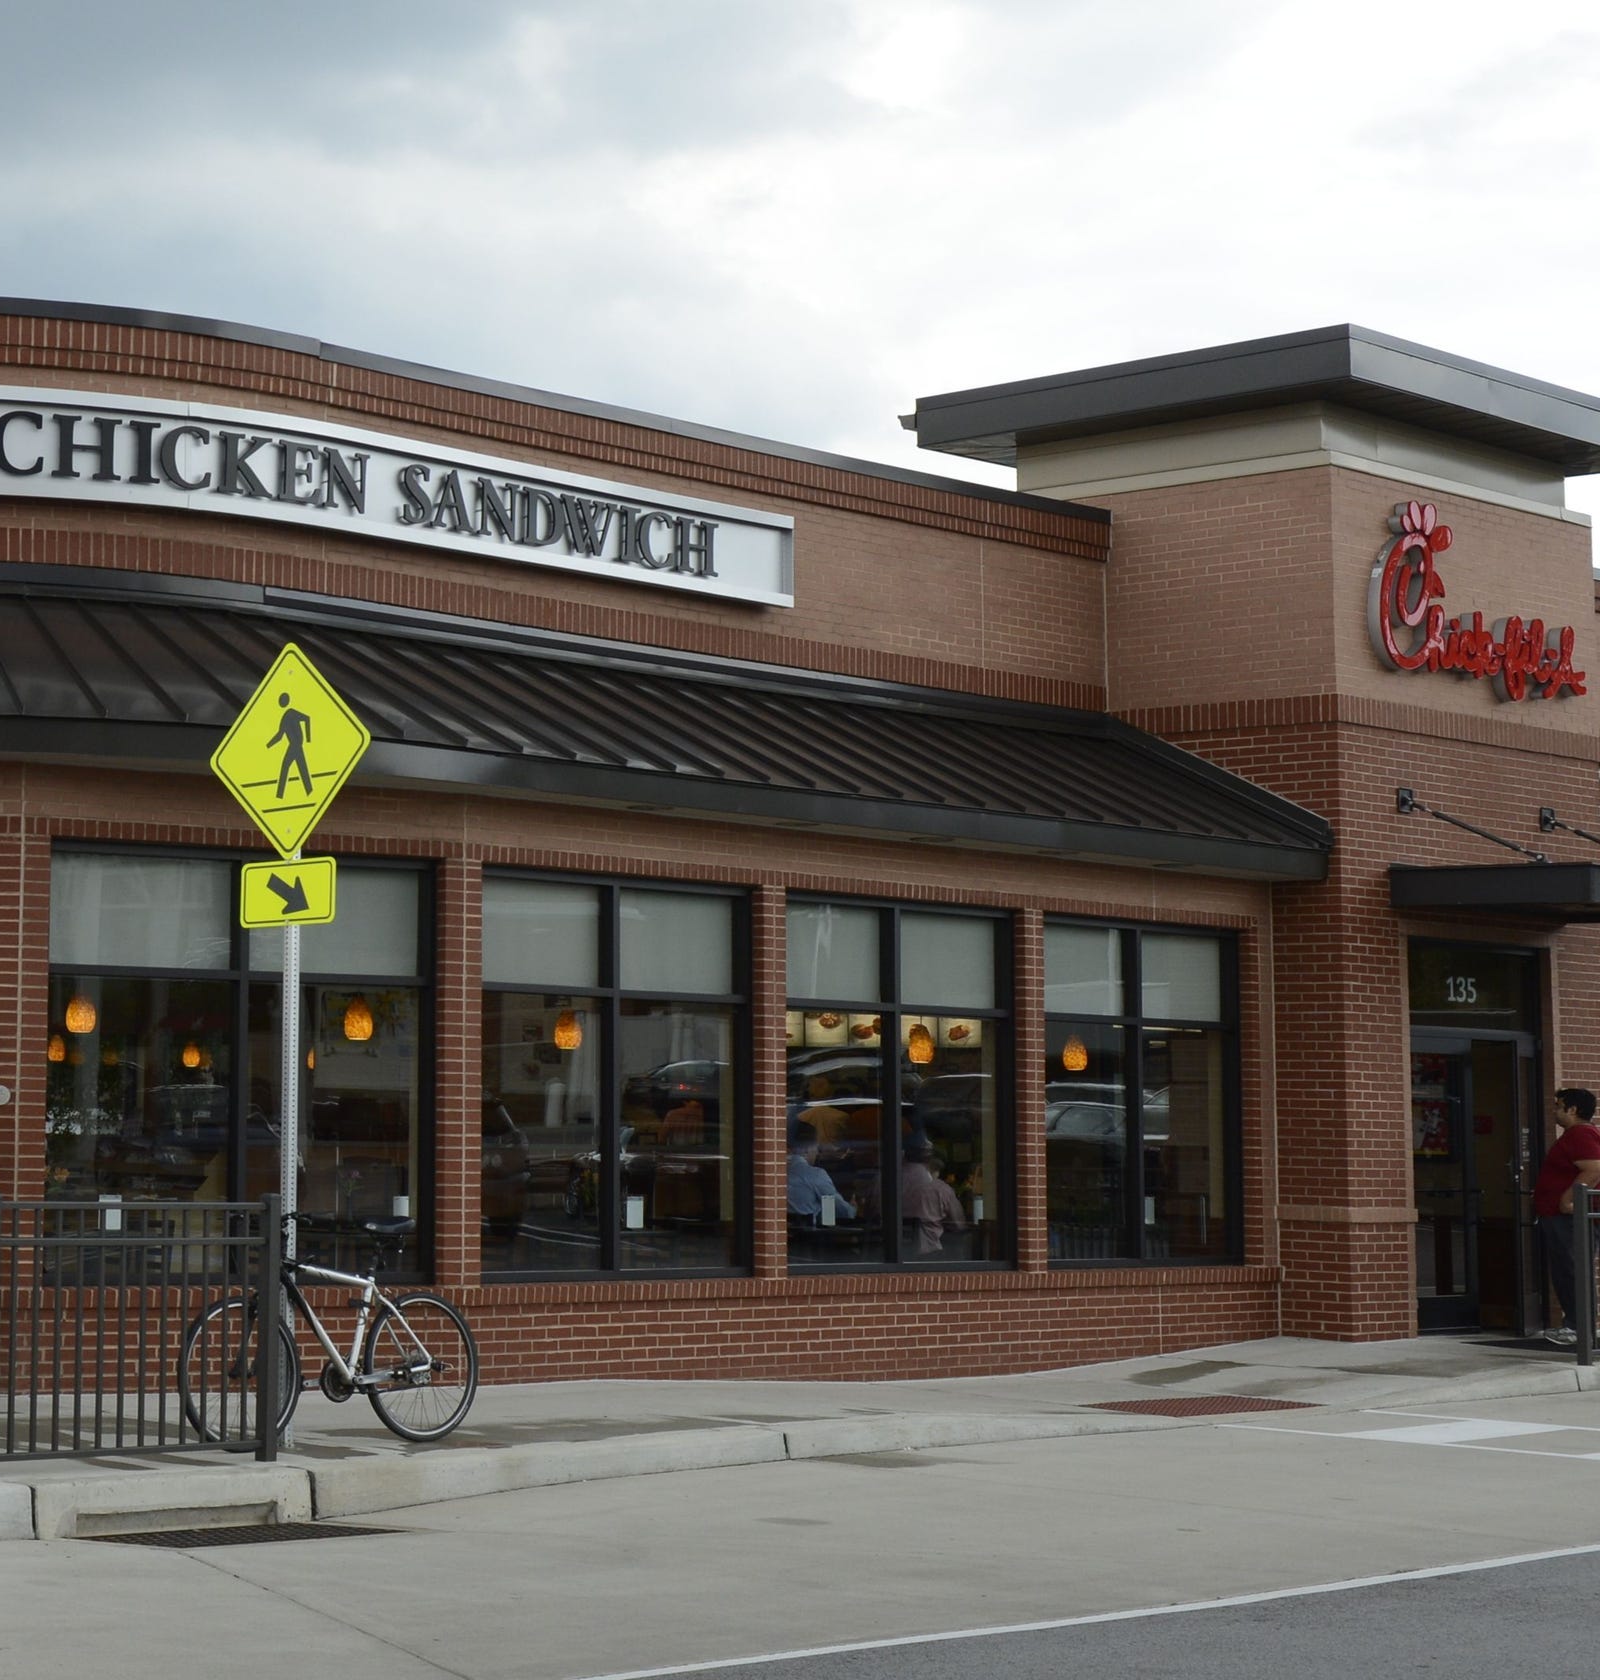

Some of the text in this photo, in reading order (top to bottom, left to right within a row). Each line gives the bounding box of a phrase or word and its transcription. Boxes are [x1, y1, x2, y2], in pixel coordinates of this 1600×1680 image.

[400, 463, 719, 577] SANDWICH
[1380, 532, 1587, 701] Chick-fil-A
[1446, 976, 1477, 1004] 135
